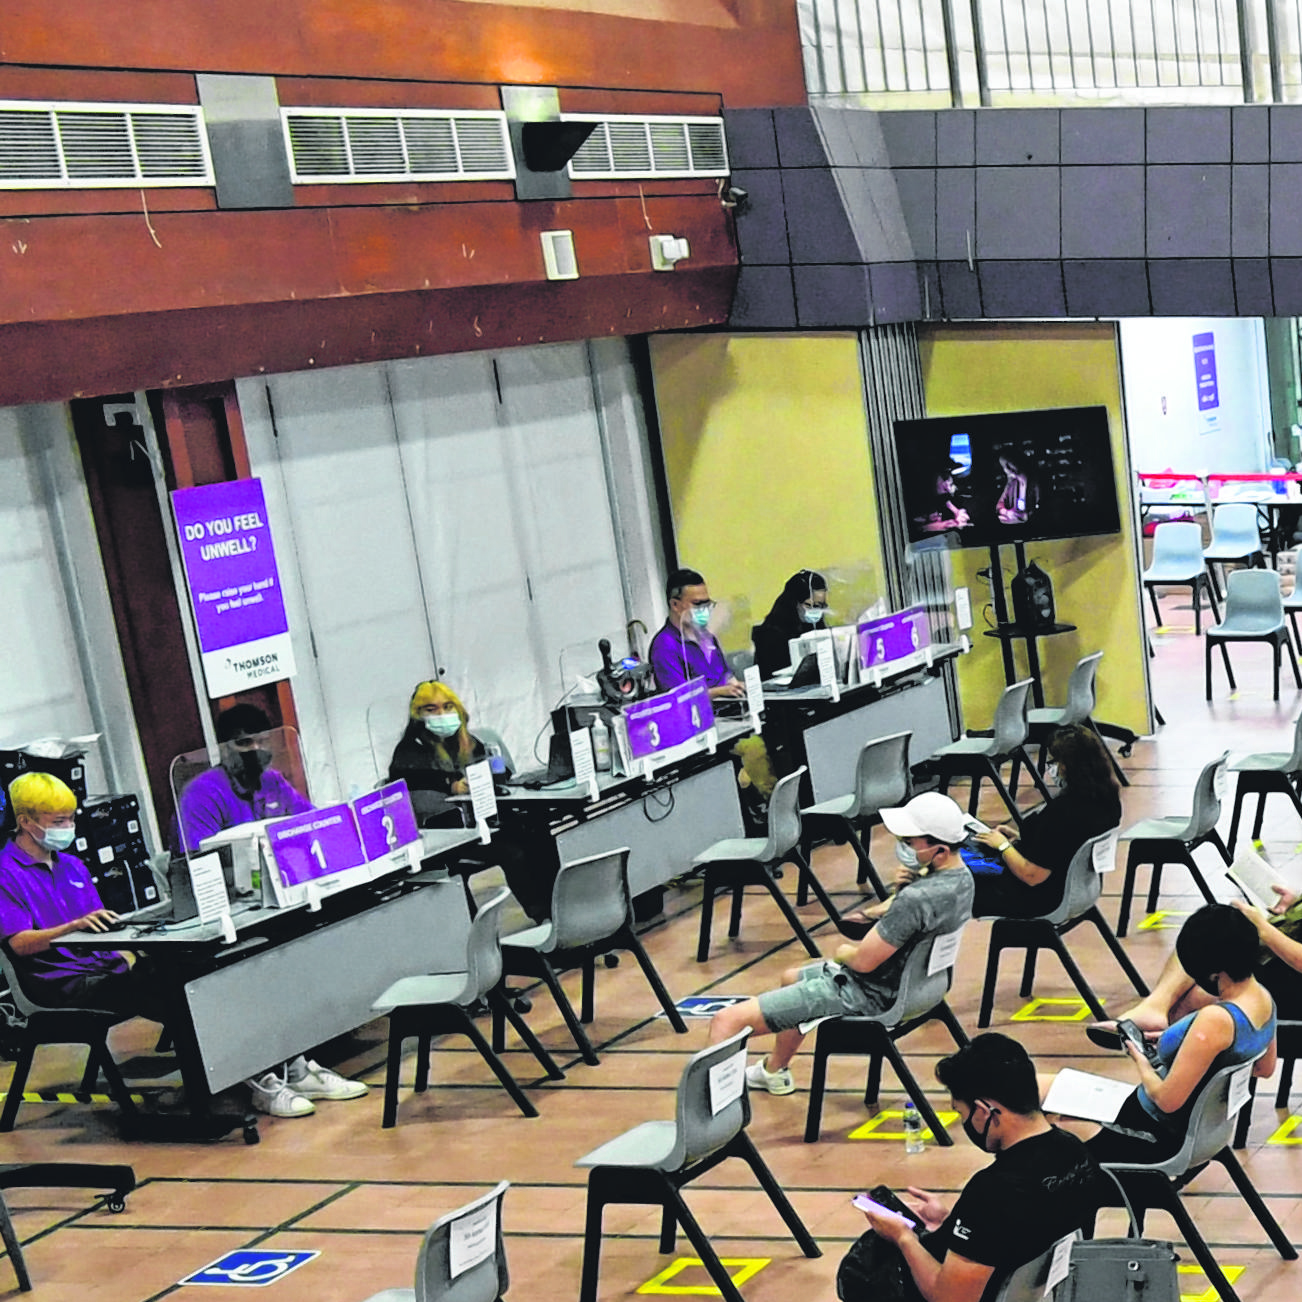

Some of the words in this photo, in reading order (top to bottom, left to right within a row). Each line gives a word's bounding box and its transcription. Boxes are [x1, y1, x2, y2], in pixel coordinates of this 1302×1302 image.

[184, 523, 205, 541] DO
[205, 517, 233, 537] YOU
[233, 512, 264, 531] FEEL
[200, 535, 257, 561] UNWELL?
[876, 638, 886, 659] 5
[910, 624, 920, 648] 6
[233, 653, 279, 673] THOMSON
[246, 665, 280, 681] MEDICAL
[691, 704, 702, 729] 4
[648, 721, 661, 747] 3
[381, 816, 398, 846] 2
[310, 839, 328, 870] 1
